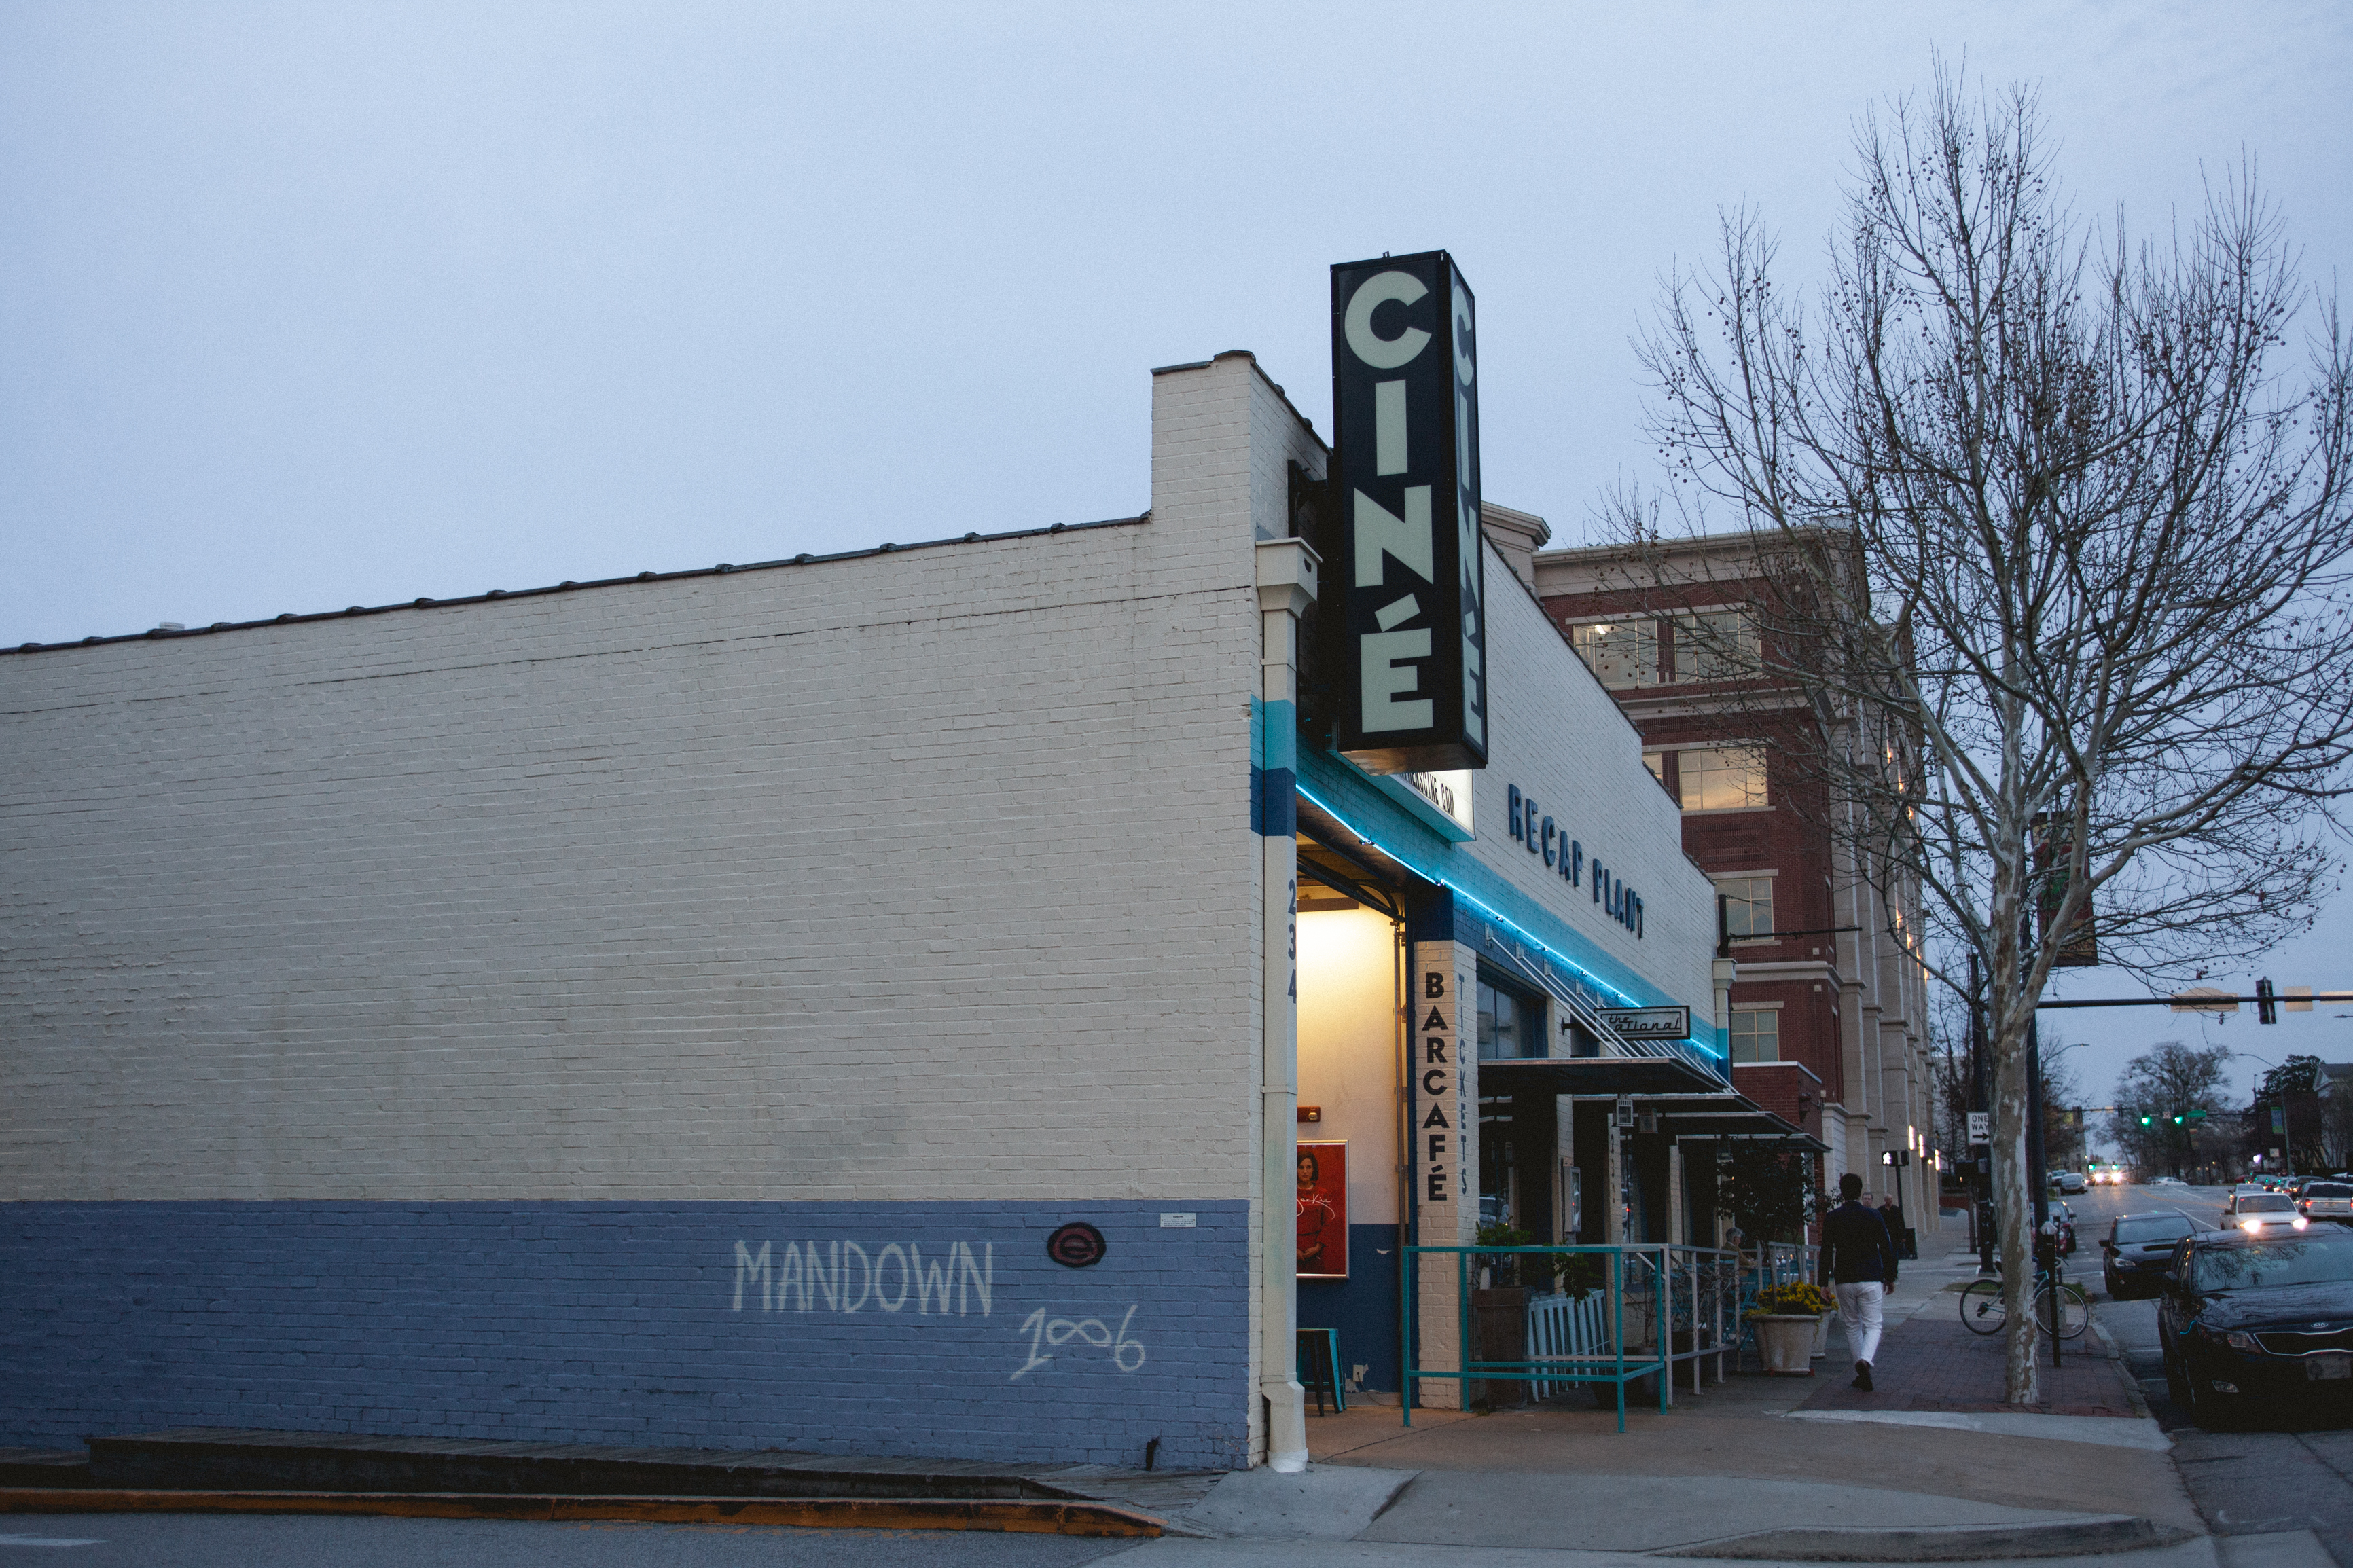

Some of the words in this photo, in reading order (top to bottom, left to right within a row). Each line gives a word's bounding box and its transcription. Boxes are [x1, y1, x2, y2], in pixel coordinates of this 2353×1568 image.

[1344, 270, 1433, 733] CINÉ
[1508, 783, 1583, 888] RECAP
[1592, 858, 1644, 939] PLANT
[1287, 879, 1297, 1004] 234
[1458, 972, 1467, 1195] TICKETS
[733, 1239, 993, 1317] MANDOWN
